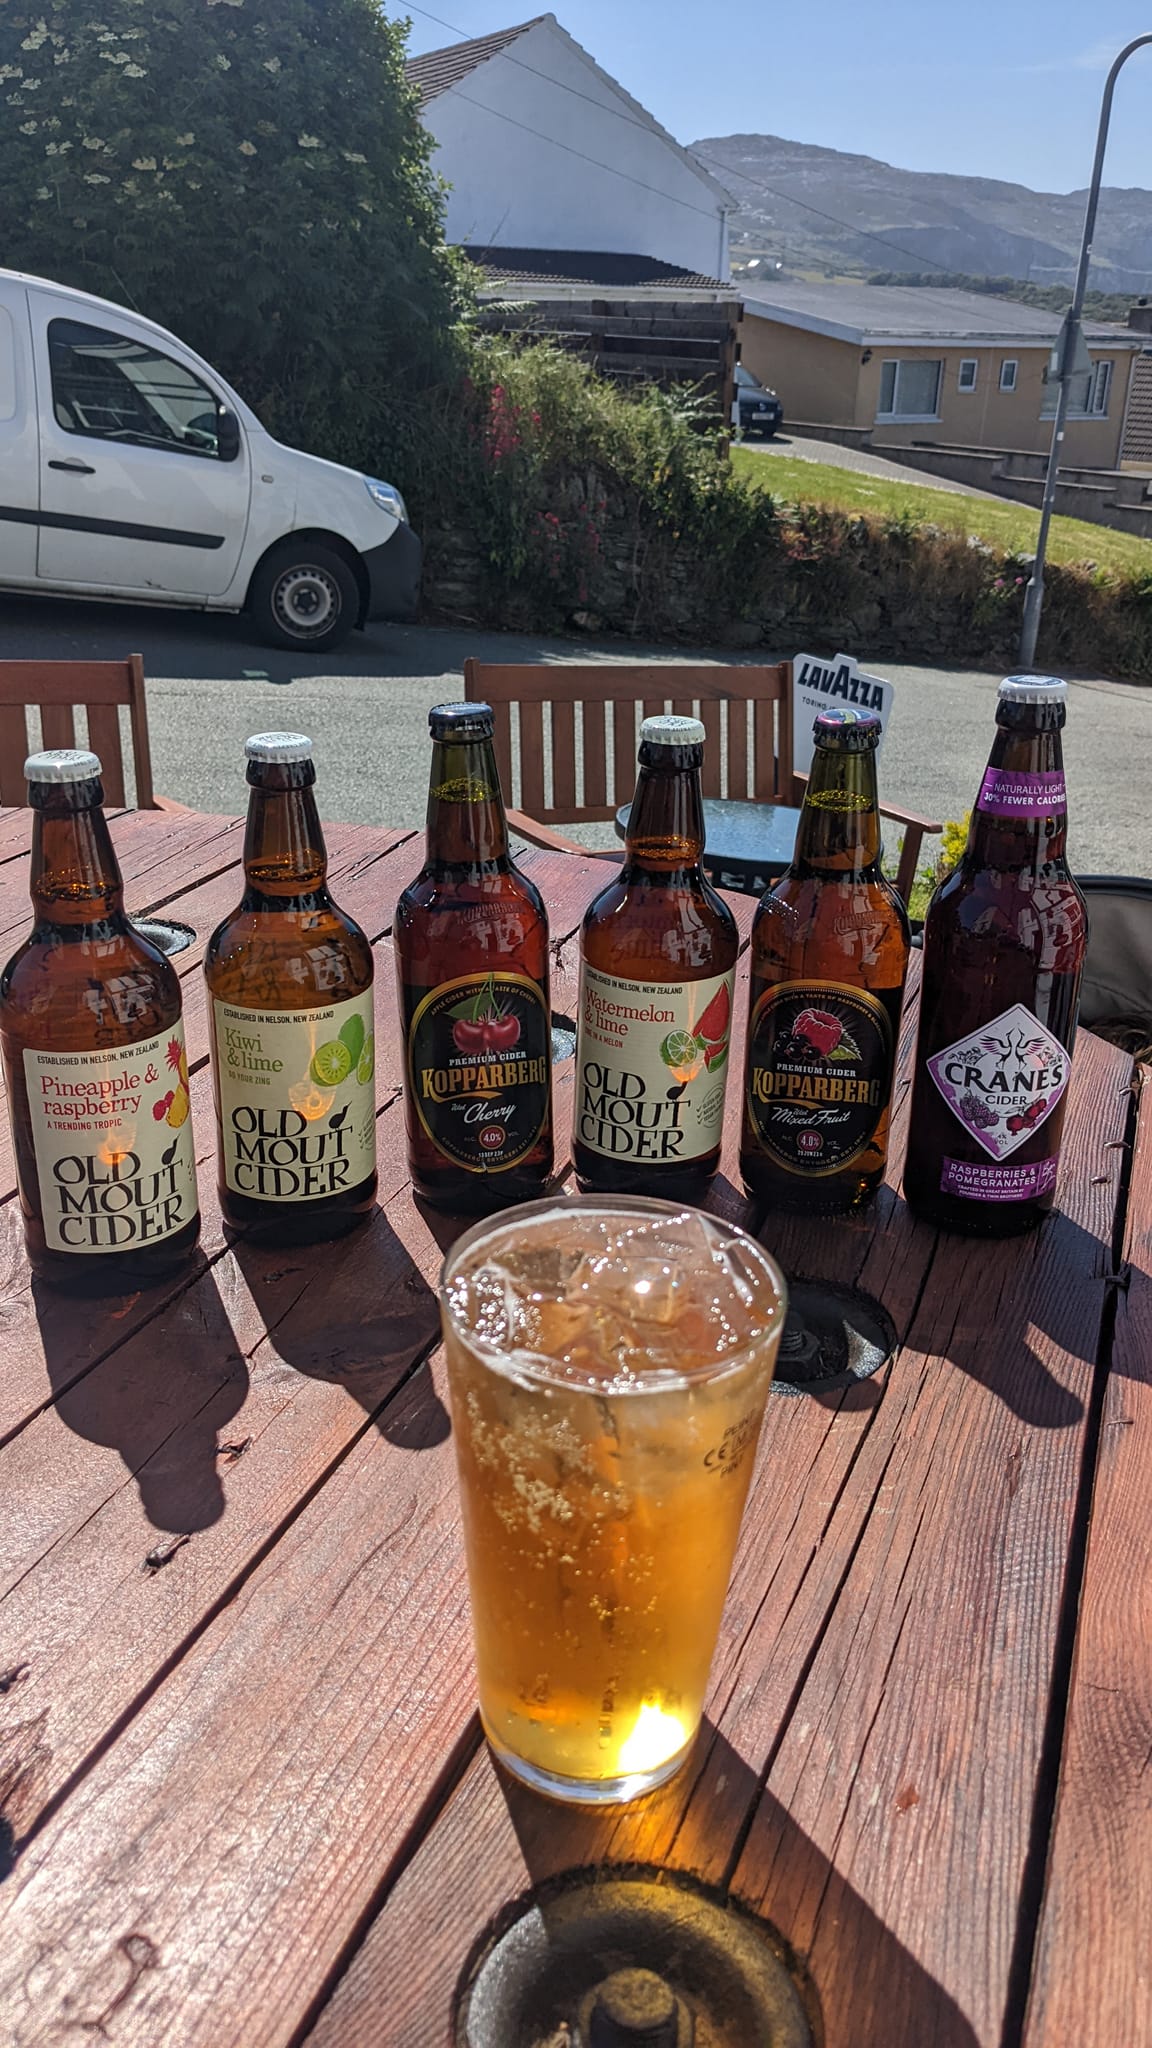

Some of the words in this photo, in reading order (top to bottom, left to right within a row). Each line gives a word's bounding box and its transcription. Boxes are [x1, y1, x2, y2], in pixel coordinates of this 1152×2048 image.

[797, 663, 884, 712] LAVAZZA
[994, 783, 1043, 794] NATURALLY
[1044, 783, 1062, 794] LIGHT
[1003, 796, 1033, 805] FEWER
[445, 991, 465, 1004] CIDER
[493, 985, 510, 993] ASTE
[612, 980, 617, 988] IN
[642, 986, 655, 994] NEW
[656, 987, 683, 995] ZEALAND
[224, 1008, 256, 1022] ESTABLISHED
[293, 1015, 307, 1023] NEW
[308, 1010, 335, 1022] ZEALAND
[586, 987, 675, 1022] Watermelon
[584, 1005, 593, 1023] &
[596, 1010, 628, 1036] lime
[224, 1027, 263, 1053] Kiwi
[603, 1036, 623, 1048] MELON
[37, 1055, 79, 1065] ESTABLISHED
[80, 1056, 88, 1065] IN
[119, 1049, 134, 1059] NEW
[135, 1041, 160, 1056] ZEALAND
[227, 1047, 240, 1067] &
[240, 1051, 283, 1072] lime
[449, 1053, 497, 1066] PREMIUM
[499, 1051, 527, 1061] CIDER
[40, 1070, 140, 1098] Pineapple
[144, 1063, 160, 1084] &
[237, 1073, 254, 1083] YOUR
[255, 1076, 271, 1086] ZING
[421, 1055, 546, 1102] KOPPARBERG
[583, 1062, 646, 1100] OLD
[776, 1062, 823, 1075] PREMIUM
[826, 1067, 856, 1078] CIDER
[945, 1062, 1063, 1093] CRANES
[751, 1067, 880, 1108] KOPPARBERG
[985, 1094, 1029, 1106] CIDER
[43, 1095, 142, 1120] raspberry
[464, 1101, 516, 1123] Cherry
[582, 1083, 690, 1129] MOUT
[771, 1107, 817, 1125] Mixed
[814, 1109, 851, 1126] Fruit
[47, 1120, 53, 1129] A
[54, 1121, 92, 1130] TRENDING
[94, 1118, 122, 1129] TROPIC
[231, 1106, 308, 1138] OLD
[232, 1125, 353, 1167] MOUT
[483, 1132, 501, 1143] 4.0%
[580, 1114, 686, 1159] CIDER
[800, 1135, 820, 1147] 4.0%
[53, 1151, 141, 1185] OLD
[233, 1158, 353, 1196] CIDER
[948, 1172, 1037, 1187] POMEGRANATES
[950, 1163, 1027, 1178] RASPBERRIES
[1029, 1167, 1036, 1176] &
[54, 1158, 184, 1214] MOUT
[58, 1194, 186, 1246] CIDER
